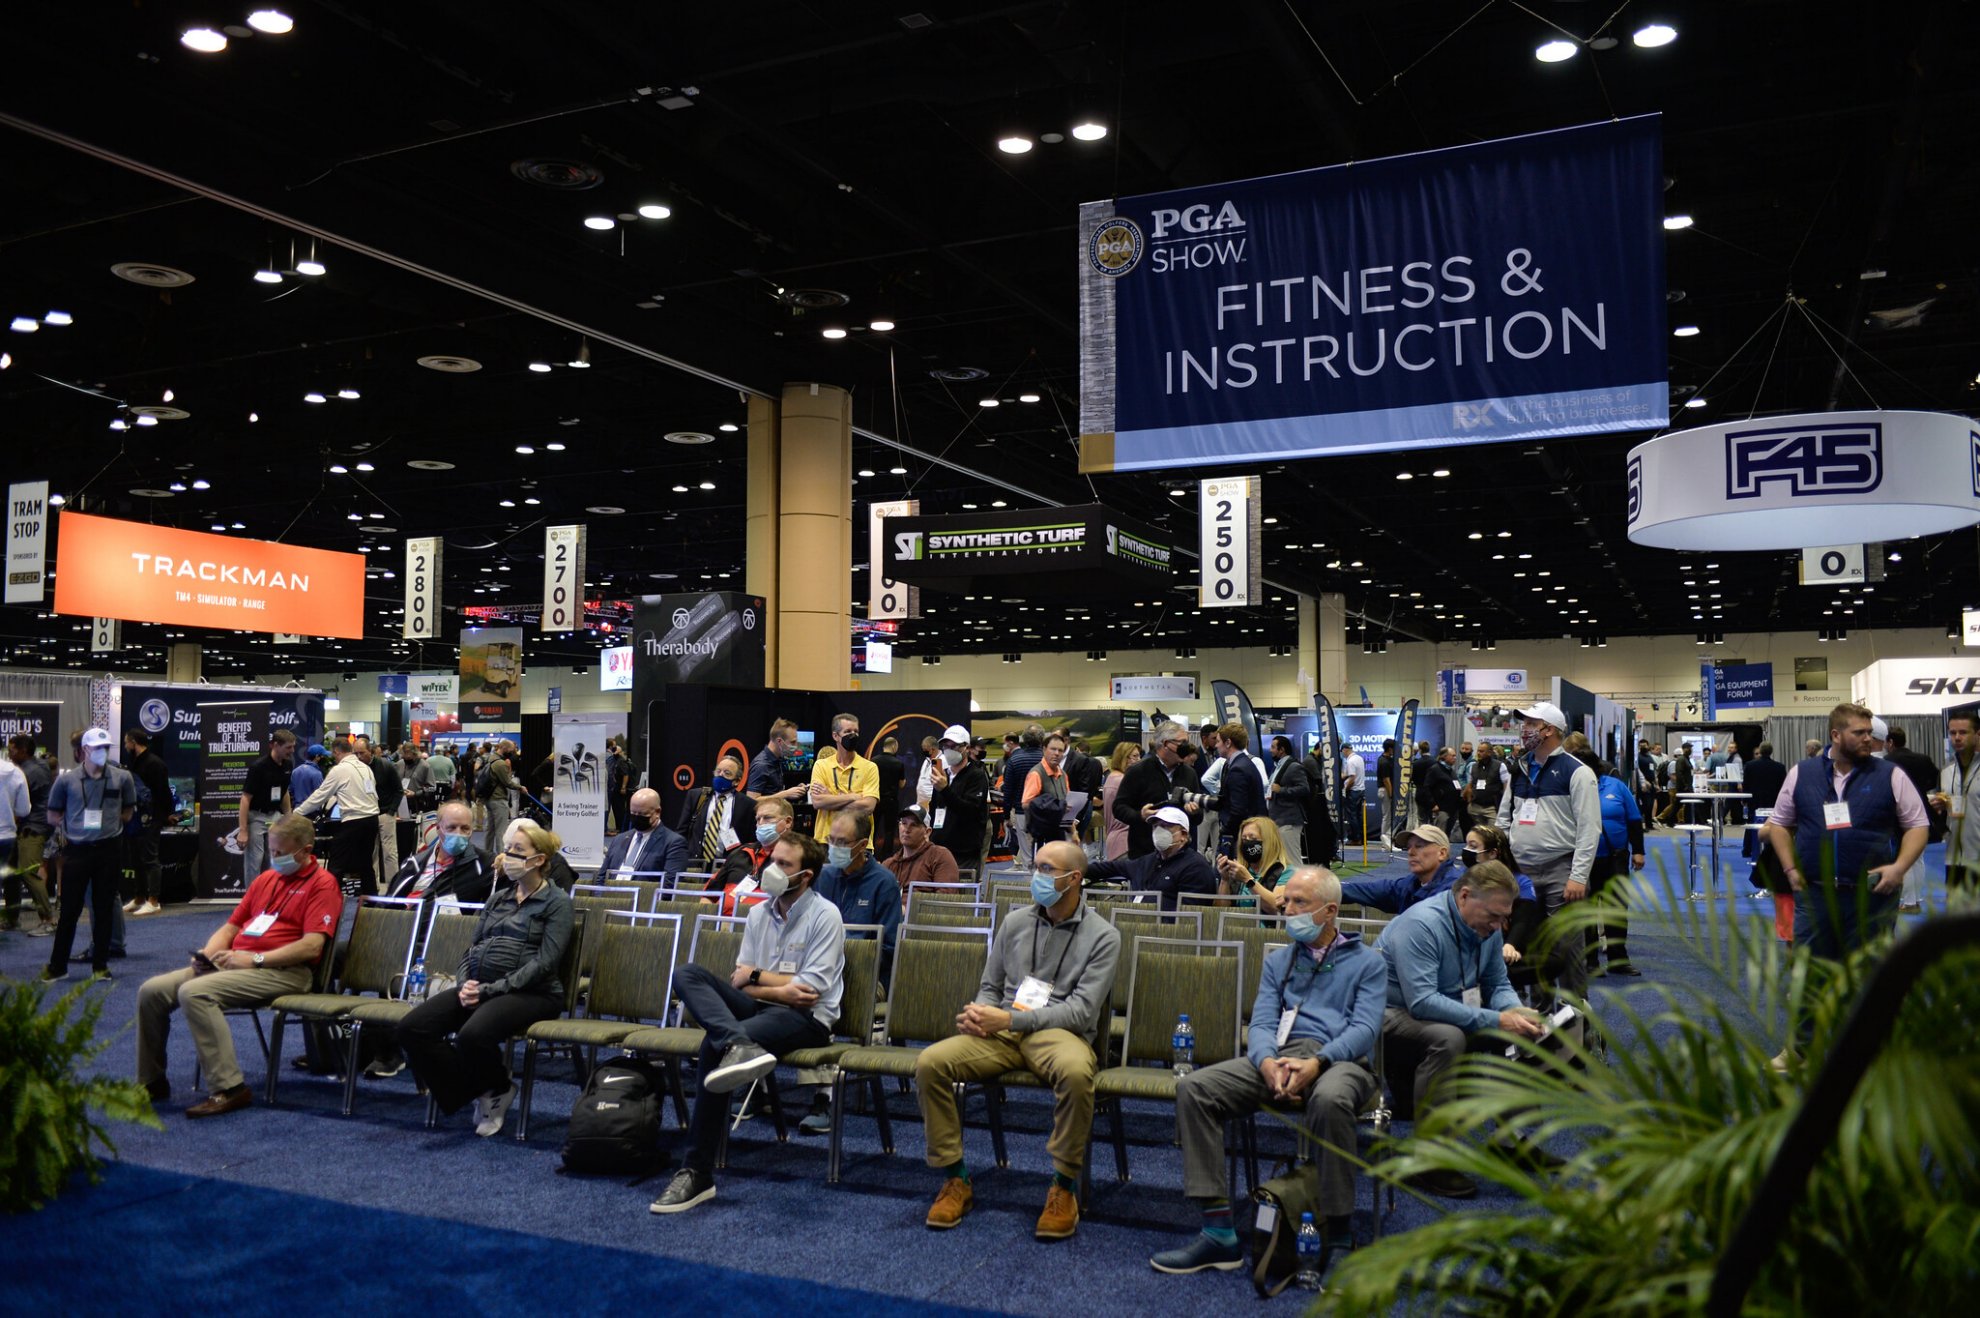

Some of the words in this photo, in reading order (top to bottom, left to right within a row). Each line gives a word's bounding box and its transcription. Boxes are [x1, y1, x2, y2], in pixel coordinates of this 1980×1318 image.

[1151, 200, 1246, 238] PGA
[1098, 240, 1133, 256] PGA
[1152, 238, 1246, 273] SHOW
[1217, 255, 1476, 330] FITNESS
[1500, 248, 1544, 297] &
[1165, 302, 1607, 394] INSTRUCTION
[1523, 398, 1546, 410] the
[1551, 393, 1613, 408] business
[1616, 390, 1632, 402] of
[1452, 404, 1494, 430] RX
[1506, 411, 1566, 425] building
[1570, 402, 1650, 419] businesses
[1731, 428, 1877, 494] F45
[14, 499, 42, 517] TRAM
[14, 521, 40, 538] STOP
[928, 533, 1034, 549] SYNTHETIC
[1036, 528, 1086, 544] TURF
[929, 546, 1083, 560] INTERNATIONAL
[1118, 534, 1154, 559] SYNTHETIC
[1154, 548, 1170, 562] TURF
[1214, 500, 1234, 600] 2500
[132, 552, 310, 592] TRACKMAN
[413, 556, 425, 633] 2800
[552, 544, 566, 626] 2700
[176, 591, 191, 602] TM4
[196, 594, 237, 607] SIMULATOR
[242, 600, 266, 610] RANGE
[644, 637, 718, 660] Therabody
[422, 682, 448, 692] WITTEK
[1727, 680, 1768, 690] EQUIPMENT
[1727, 690, 1752, 698] FORUM
[218, 722, 252, 733] BENEFITS
[222, 733, 232, 743] OF
[234, 732, 247, 742] THE
[208, 741, 260, 753] TRUETURNPRO
[1349, 735, 1361, 743] 3D
[1398, 710, 1413, 798] enform
